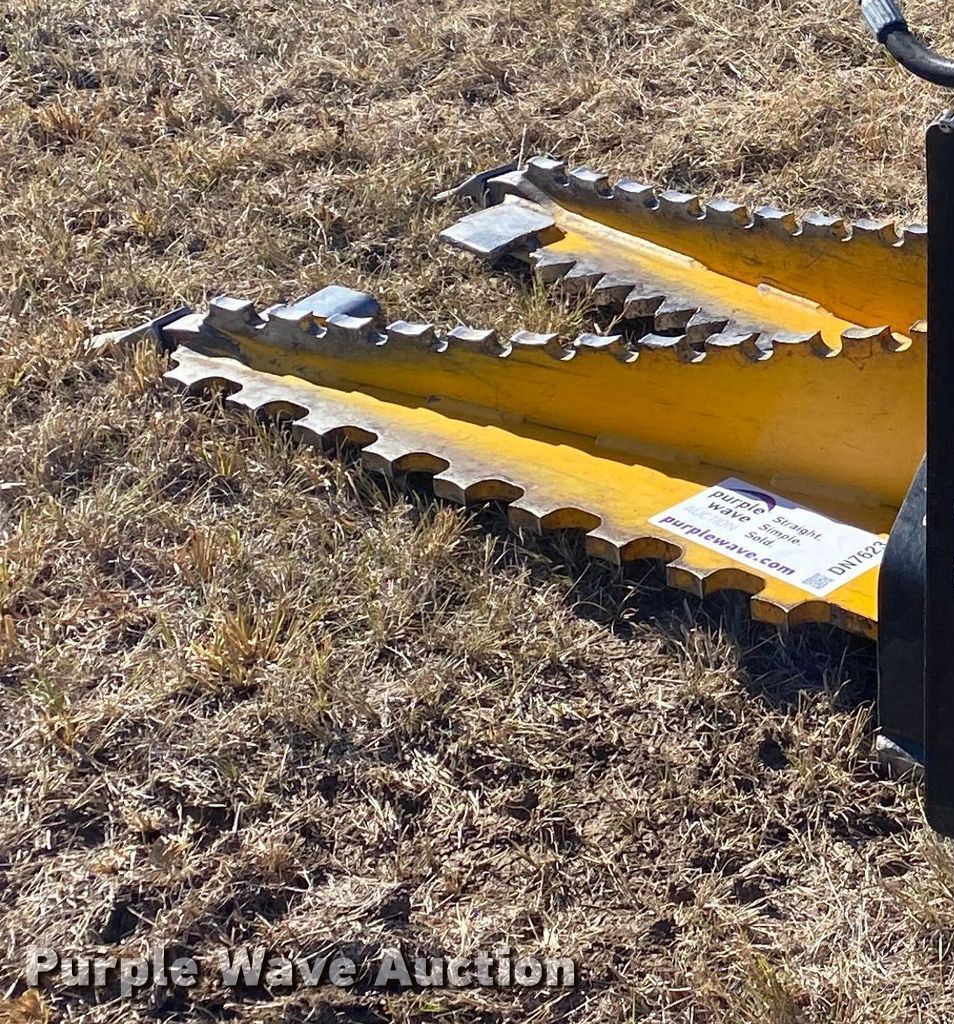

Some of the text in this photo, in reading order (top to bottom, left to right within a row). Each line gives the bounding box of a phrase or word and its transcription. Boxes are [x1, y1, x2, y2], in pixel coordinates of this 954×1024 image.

[707, 490, 766, 516] purple
[707, 500, 752, 524] wave
[744, 531, 774, 549] Sold.
[758, 524, 802, 547] Simple.
[772, 515, 823, 542] Straight.
[659, 514, 797, 576] purplewave.com
